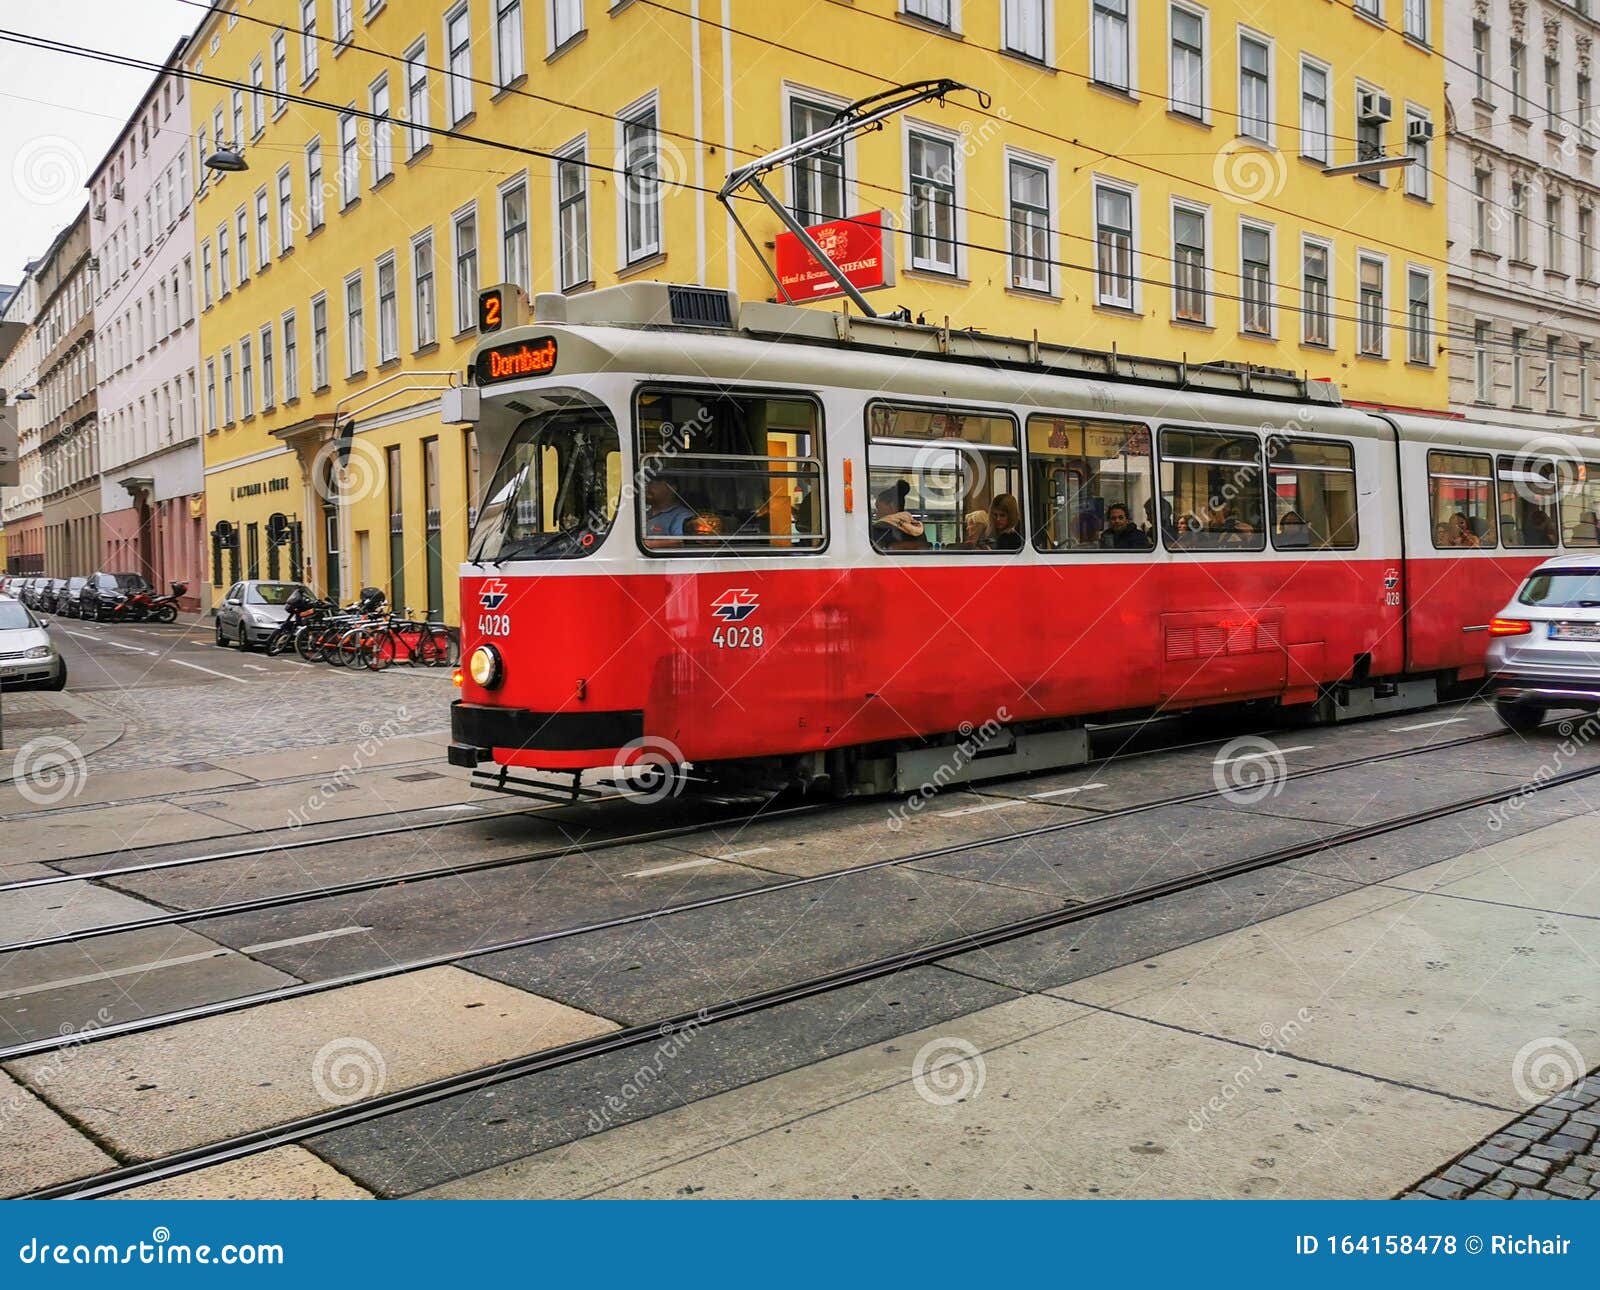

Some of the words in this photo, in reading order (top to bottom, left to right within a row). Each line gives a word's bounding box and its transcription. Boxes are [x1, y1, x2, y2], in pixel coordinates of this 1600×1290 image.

[486, 297, 501, 325] 2
[478, 613, 510, 636] 4028
[712, 626, 764, 649] 4028
